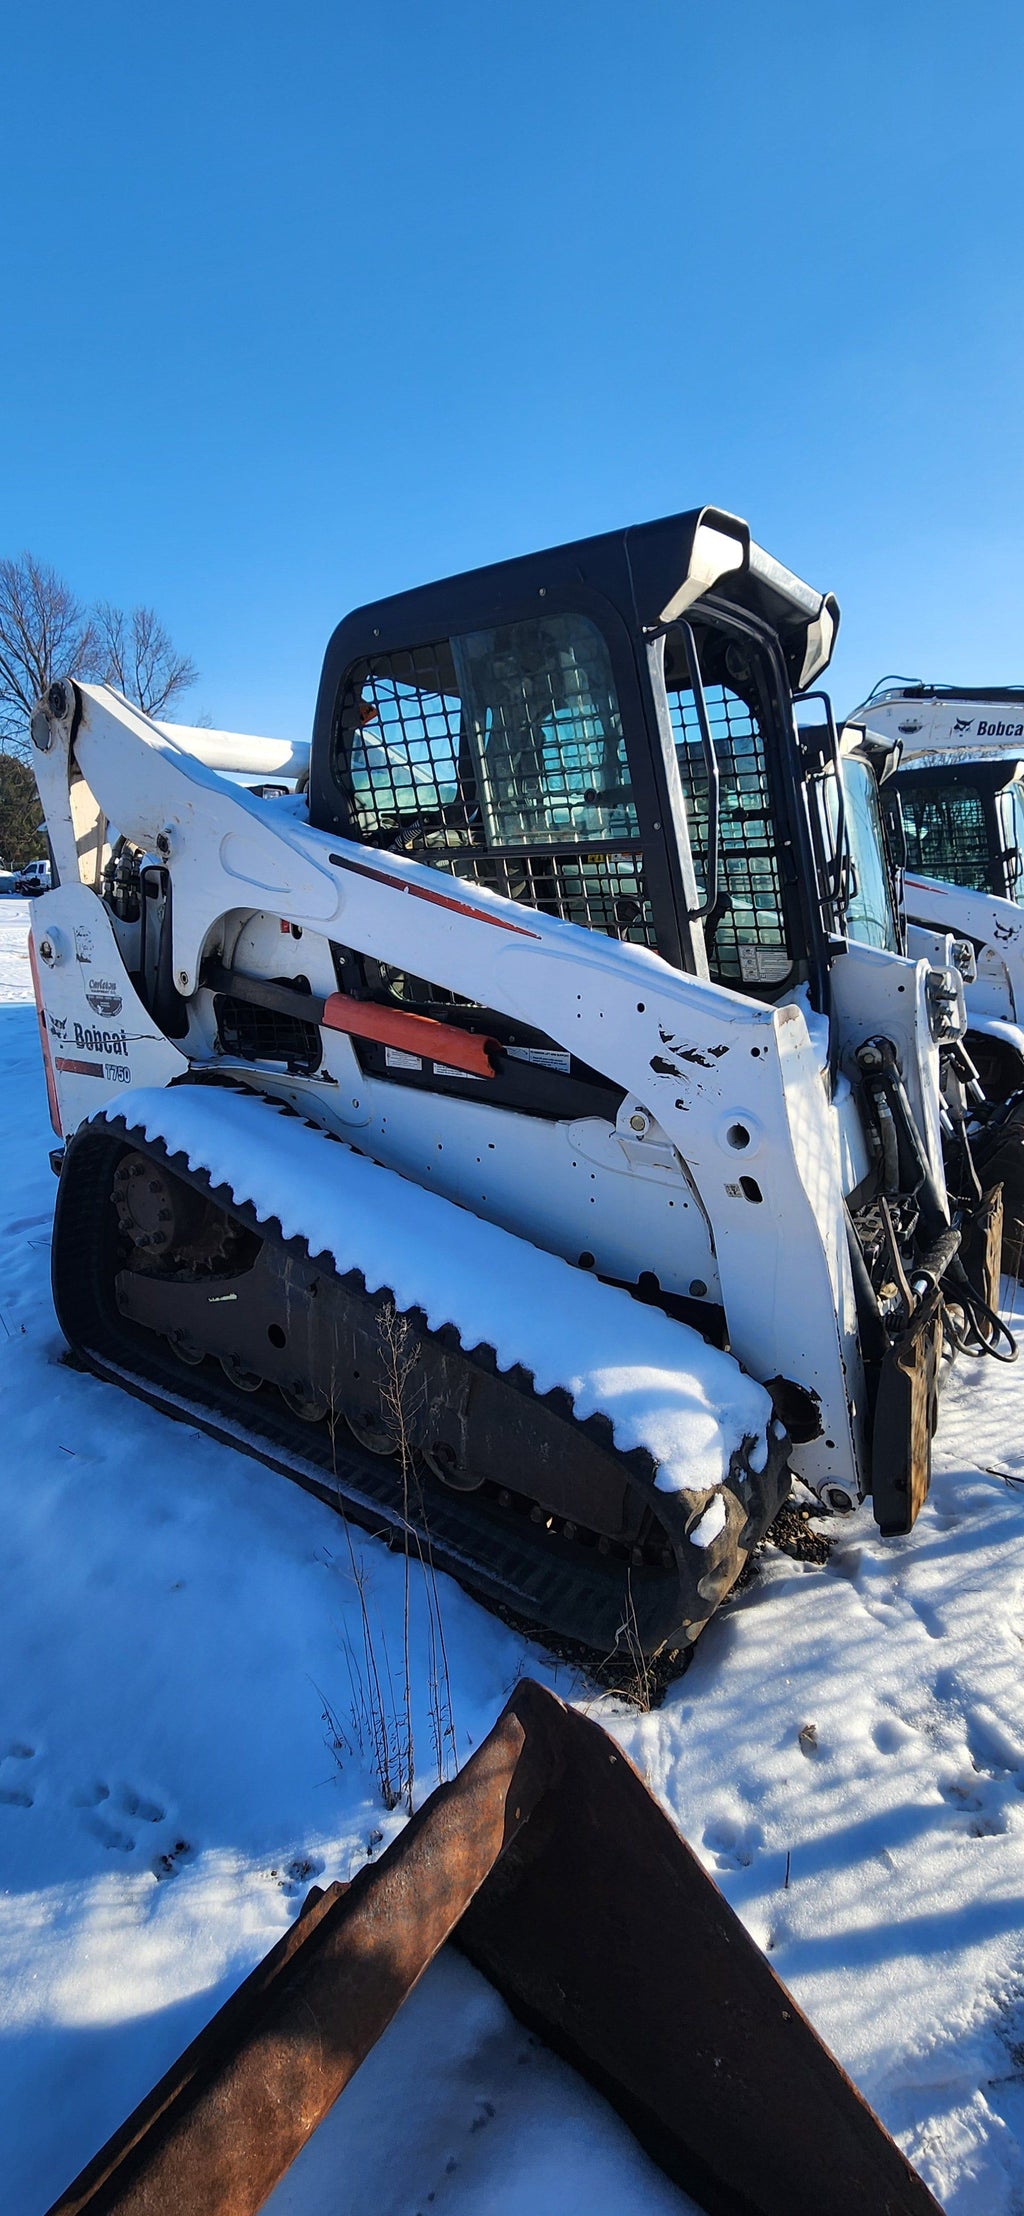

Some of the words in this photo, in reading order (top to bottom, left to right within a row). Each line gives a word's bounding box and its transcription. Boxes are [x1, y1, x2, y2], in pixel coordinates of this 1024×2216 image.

[977, 721, 1024, 736] Bobca
[73, 1021, 128, 1056] Bobcat
[105, 1064, 131, 1083] T750
